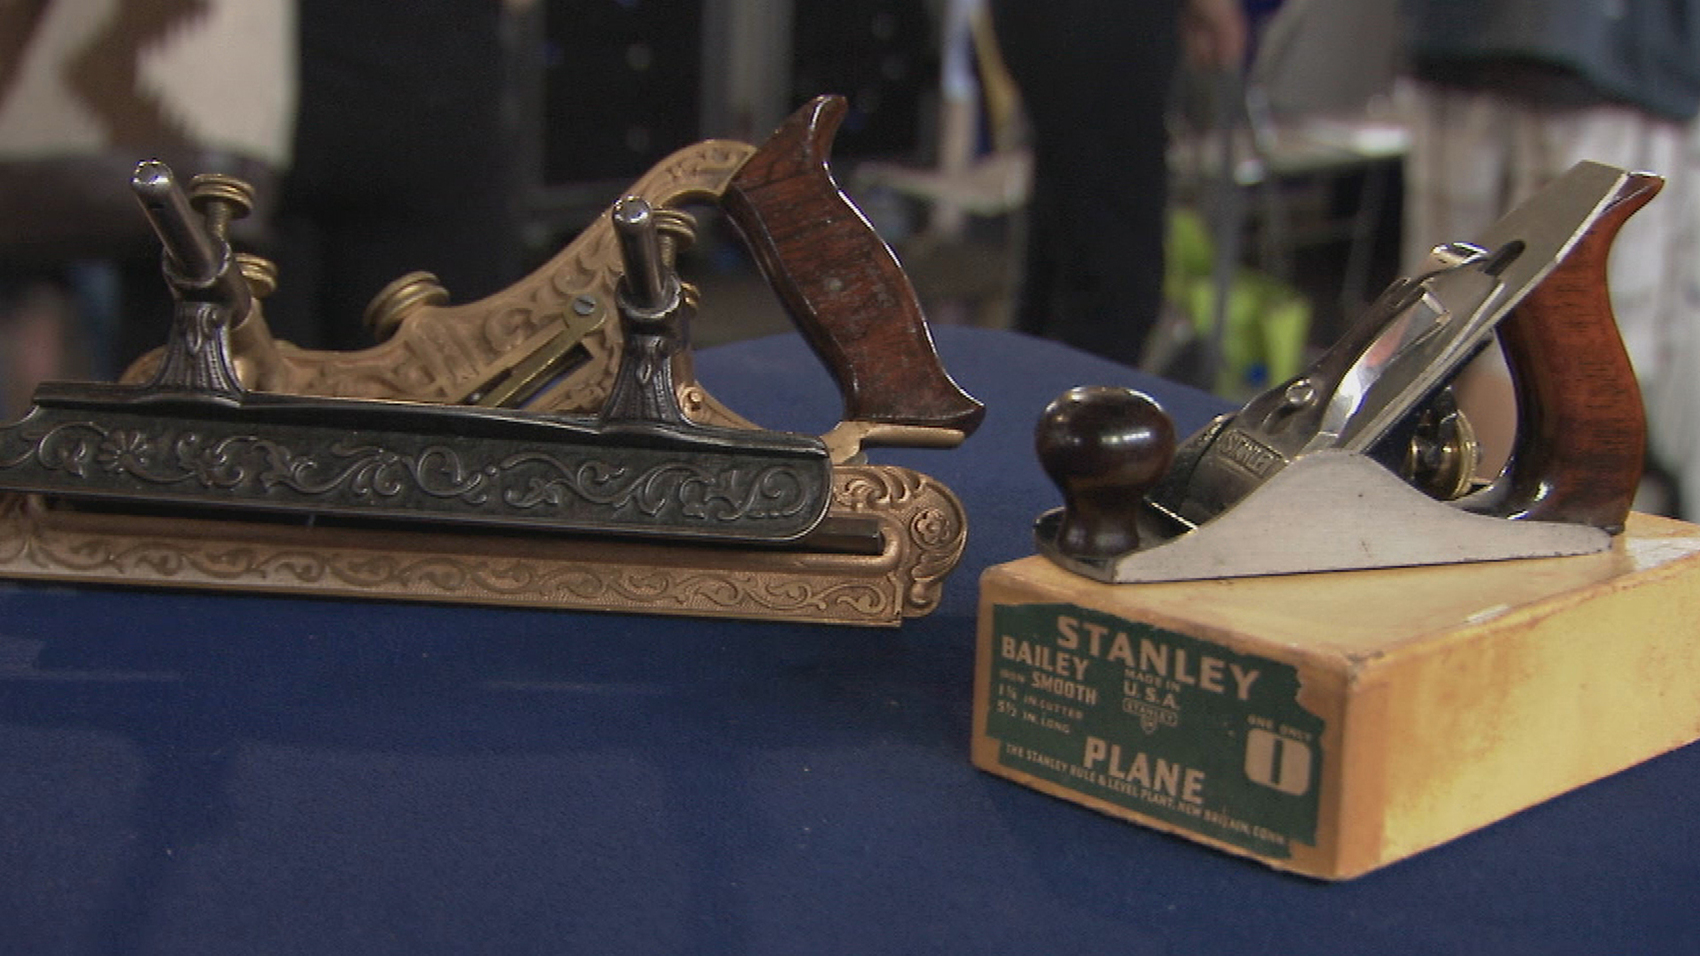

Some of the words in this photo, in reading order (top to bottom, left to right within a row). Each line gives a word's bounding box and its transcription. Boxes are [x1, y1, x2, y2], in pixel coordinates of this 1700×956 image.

[1002, 635, 1088, 681] BAILEY
[1057, 615, 1260, 700] STANLEY
[1031, 671, 1097, 705] SMOOTH
[1005, 743, 1023, 758] THE
[1026, 749, 1068, 772] STANLEY
[1084, 736, 1206, 804] PLANE
